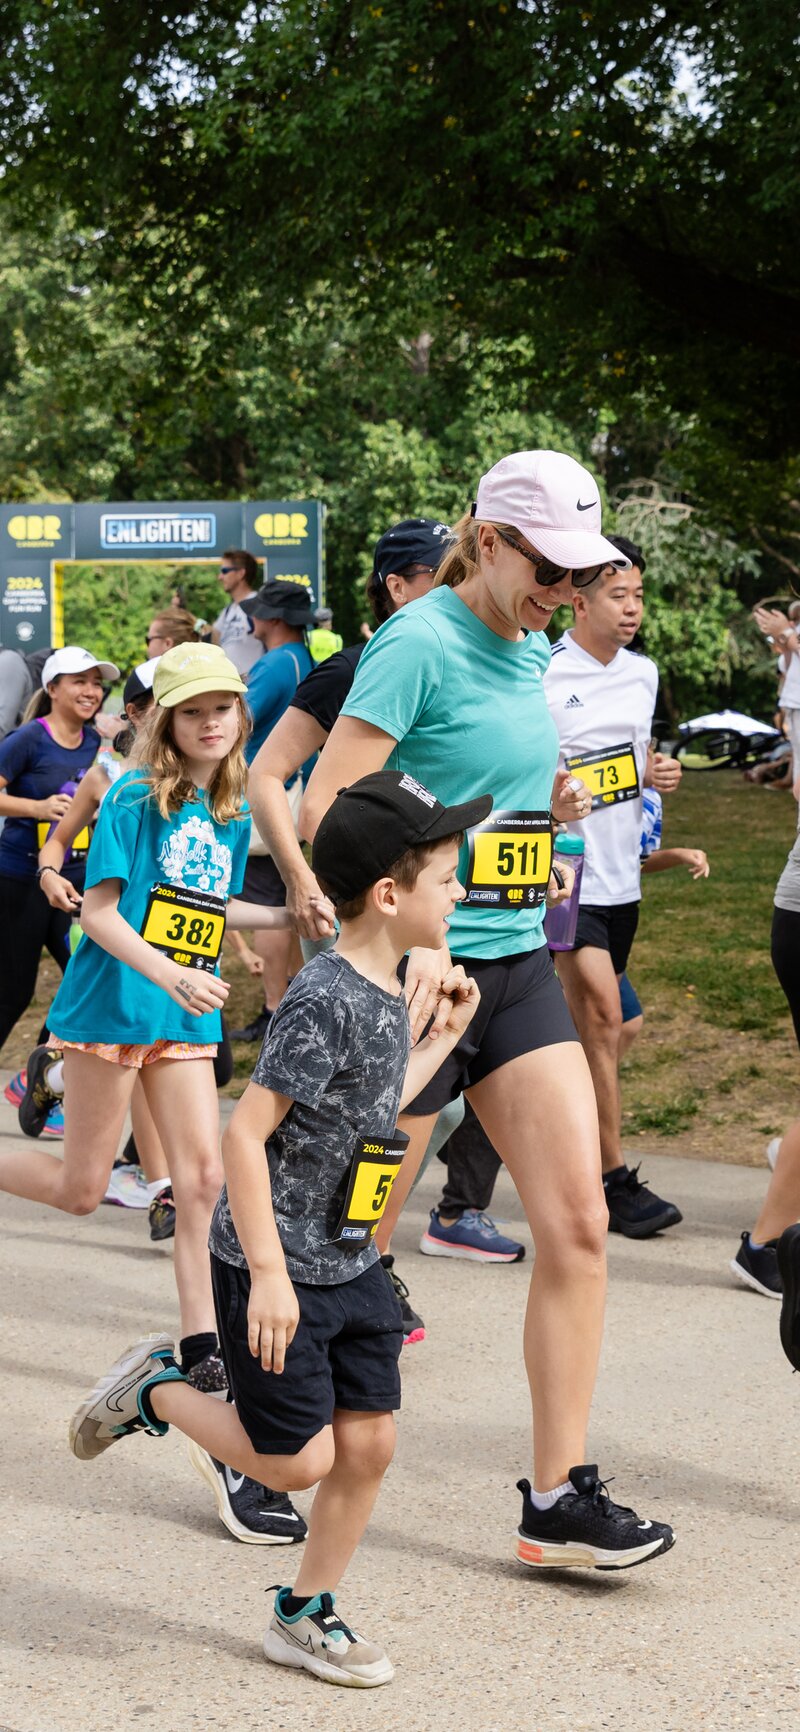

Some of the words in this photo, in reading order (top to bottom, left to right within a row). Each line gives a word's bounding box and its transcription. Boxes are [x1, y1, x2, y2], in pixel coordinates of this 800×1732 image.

[7, 515, 62, 540] CBR
[106, 519, 205, 543] ENLIGHTEN
[254, 512, 309, 538] CBR
[7, 576, 43, 590] 2024
[593, 765, 619, 788] 73
[496, 841, 539, 876] 511
[156, 887, 176, 899] 2024
[507, 888, 524, 900] CBR
[166, 913, 215, 949] 382
[173, 952, 192, 964] CBR
[362, 1143, 384, 1155] 2024
[371, 1174, 395, 1211] 5
